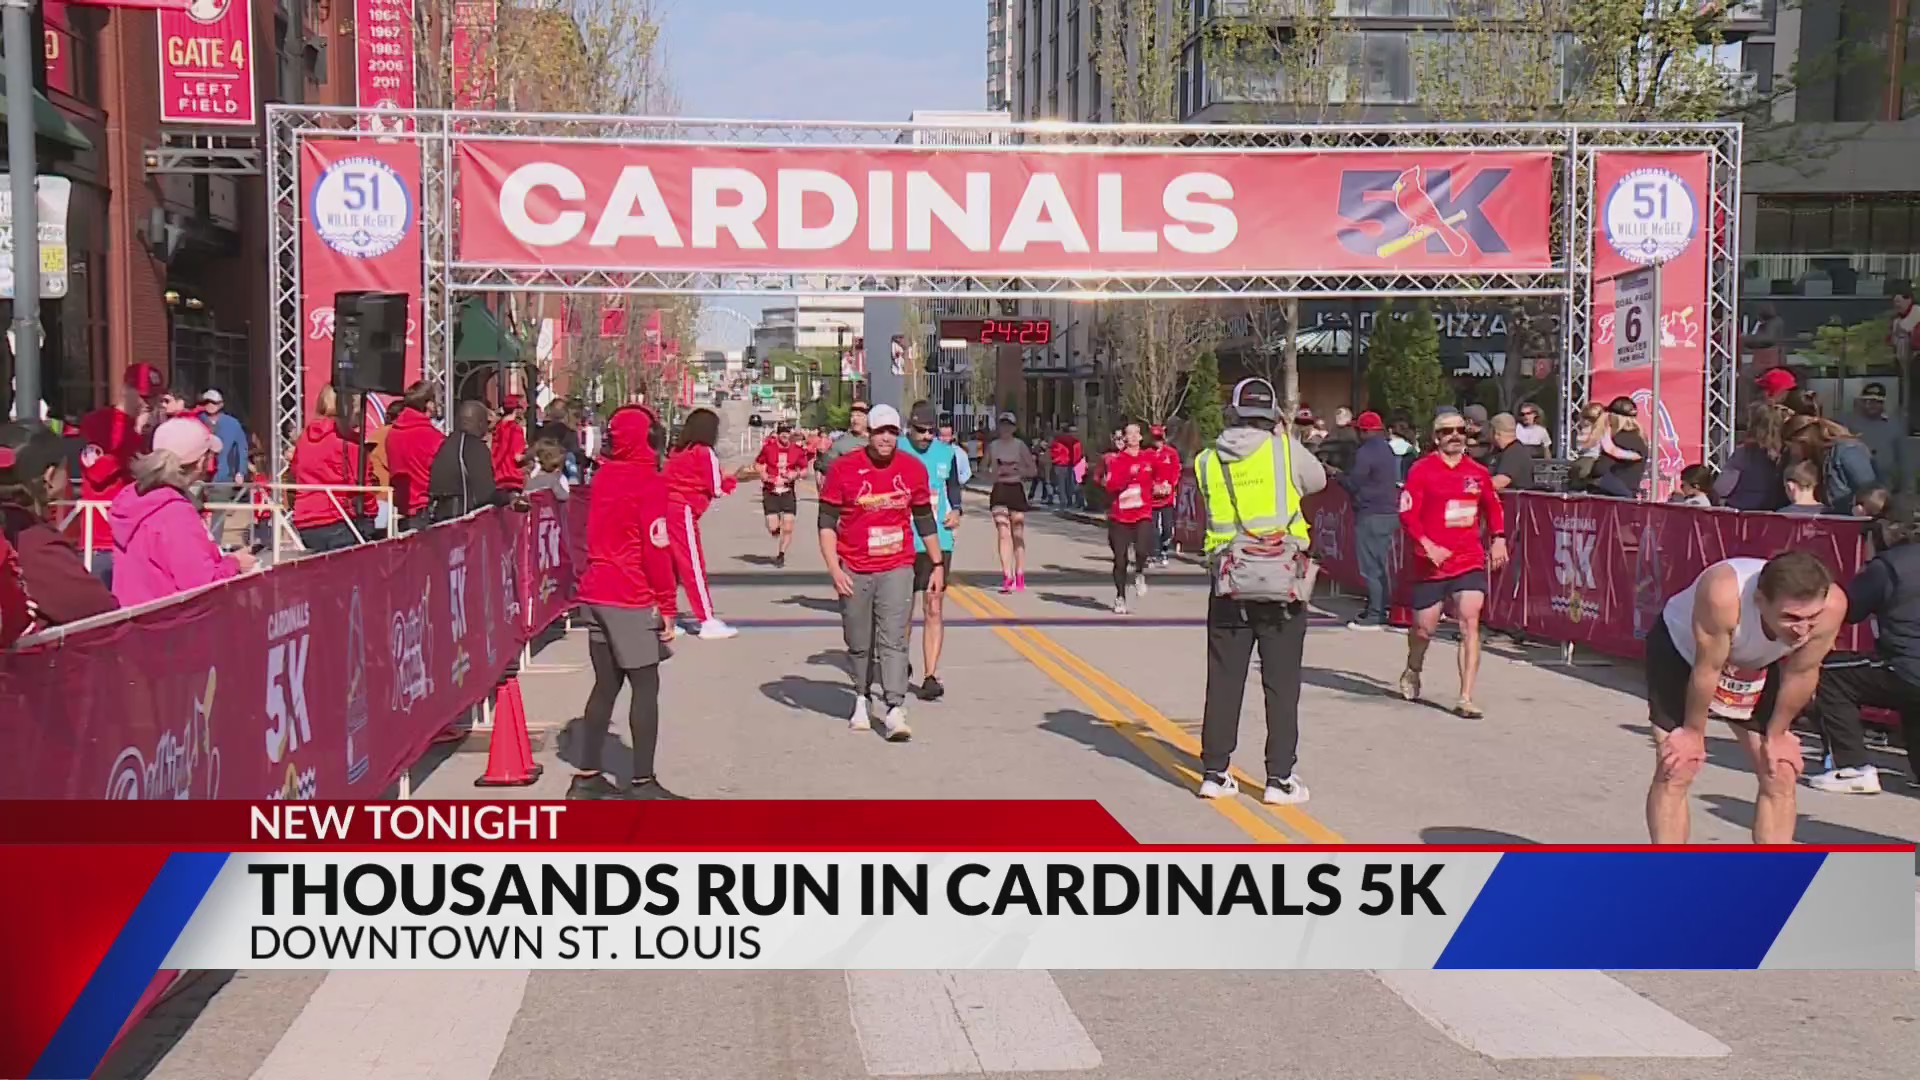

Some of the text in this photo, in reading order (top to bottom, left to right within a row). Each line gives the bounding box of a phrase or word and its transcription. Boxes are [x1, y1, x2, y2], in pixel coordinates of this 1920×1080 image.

[368, 9, 400, 21] 1964
[370, 26, 400, 38] 1967
[168, 36, 246, 70] GATE 4
[370, 43, 401, 56] 1982
[368, 59, 404, 72] 2006
[183, 82, 233, 97] LEFT
[372, 76, 400, 89] 2011
[178, 98, 238, 114] FIELD
[343, 172, 380, 211] 51
[499, 162, 1512, 254] CARDINALS 5K
[1633, 182, 1669, 220] 51
[327, 213, 361, 227] WILLIE
[1617, 222, 1648, 236] WILLIE
[1430, 312, 1508, 338] PIZZA
[1625, 305, 1642, 343] 6
[1617, 341, 1648, 355] MINUTES
[1554, 531, 1597, 590] 5K
[267, 600, 311, 641] CARDINALS
[265, 633, 313, 764] 5K
